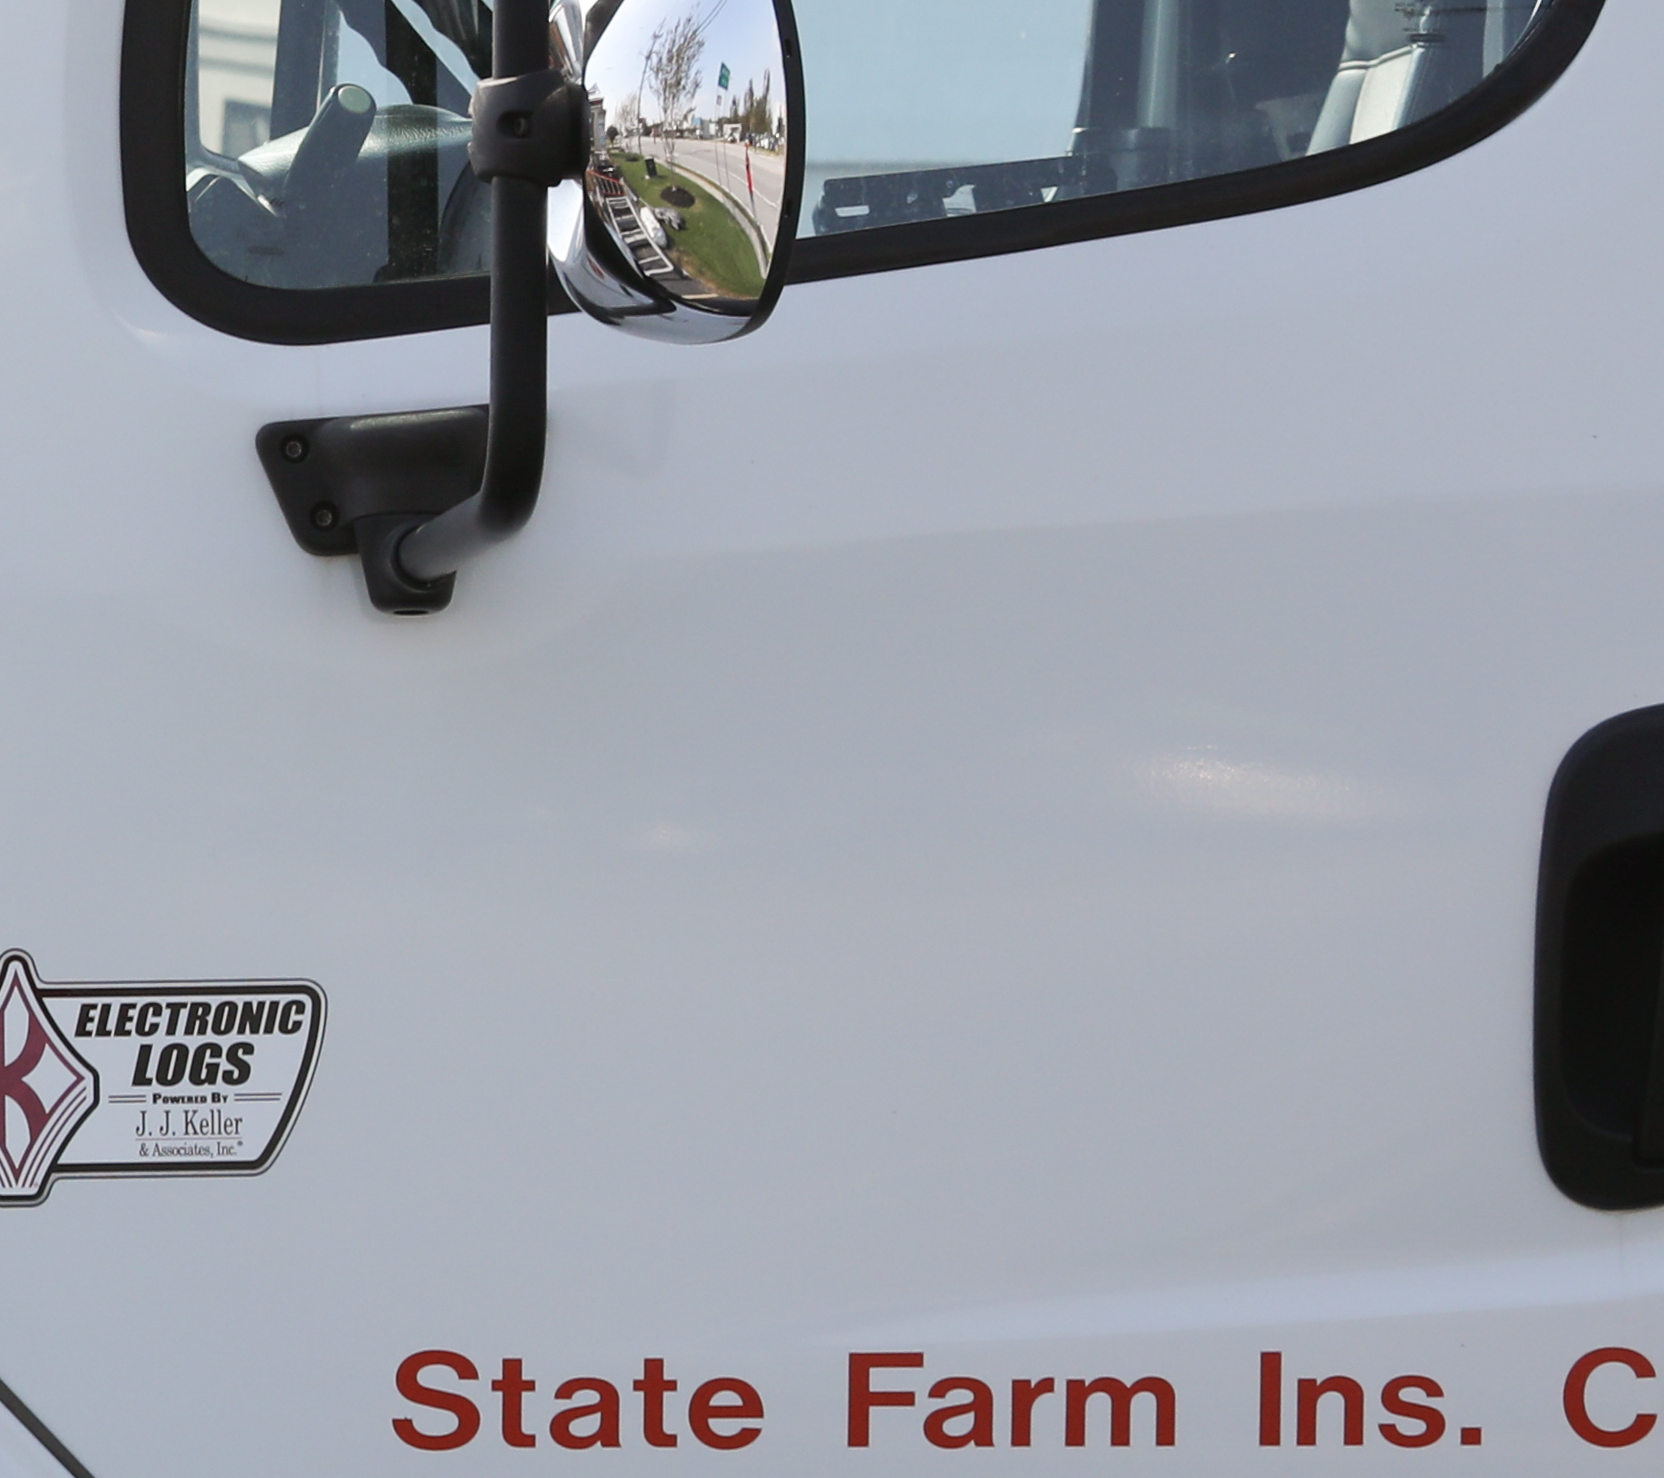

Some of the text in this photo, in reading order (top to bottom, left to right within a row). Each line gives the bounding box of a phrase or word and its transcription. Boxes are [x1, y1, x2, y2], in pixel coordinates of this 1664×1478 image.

[74, 1000, 306, 1037] ELECTRONIC
[131, 1042, 255, 1086] LOGS
[136, 1108, 243, 1136] J. J. Keller
[139, 1142, 149, 1157] &
[152, 1142, 213, 1158] Associates,
[395, 1351, 762, 1450] State
[850, 1354, 1175, 1448] Farm
[1261, 1353, 1481, 1447] Ins.
